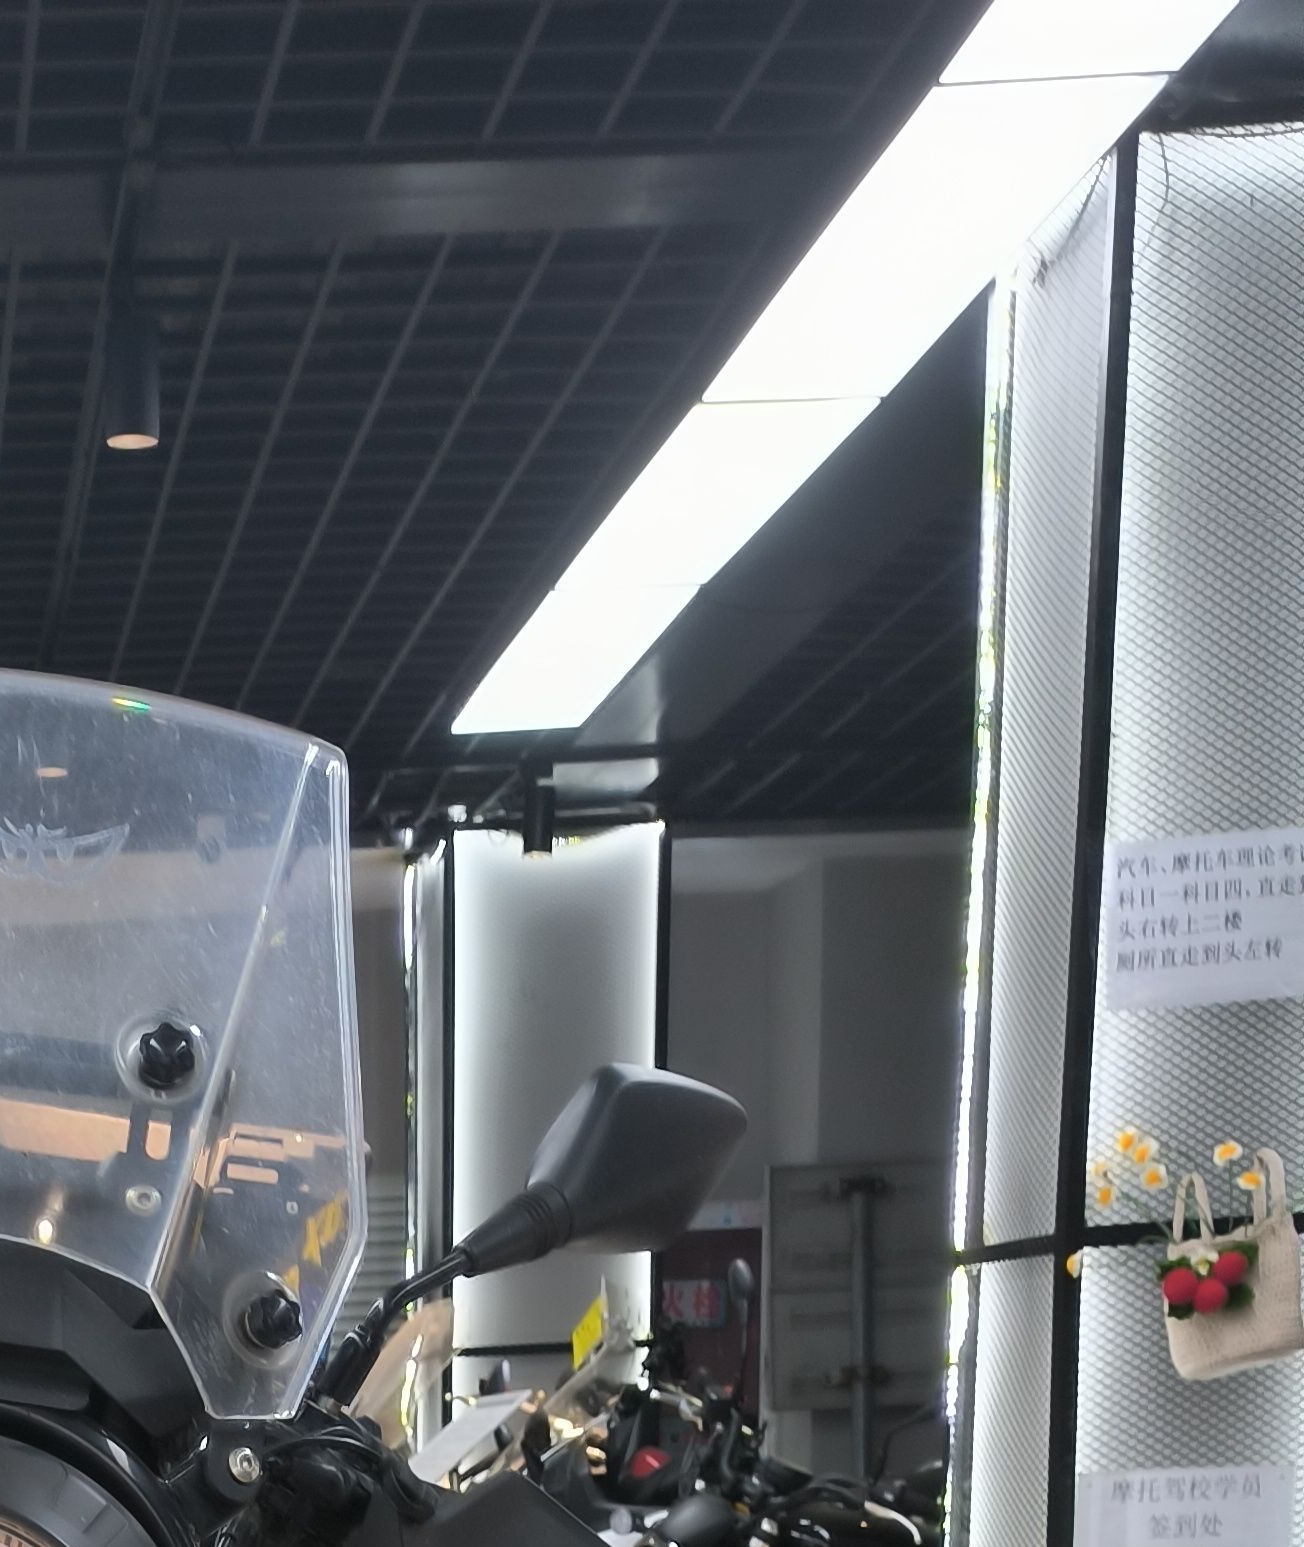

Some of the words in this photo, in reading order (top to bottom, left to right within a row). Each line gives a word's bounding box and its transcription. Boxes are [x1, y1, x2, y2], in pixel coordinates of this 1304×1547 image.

[1118, 909, 1243, 940] 头右转上二楼
[1111, 1473, 1261, 1503] 摩托驾校学员
[1149, 1512, 1223, 1539] 签到处
